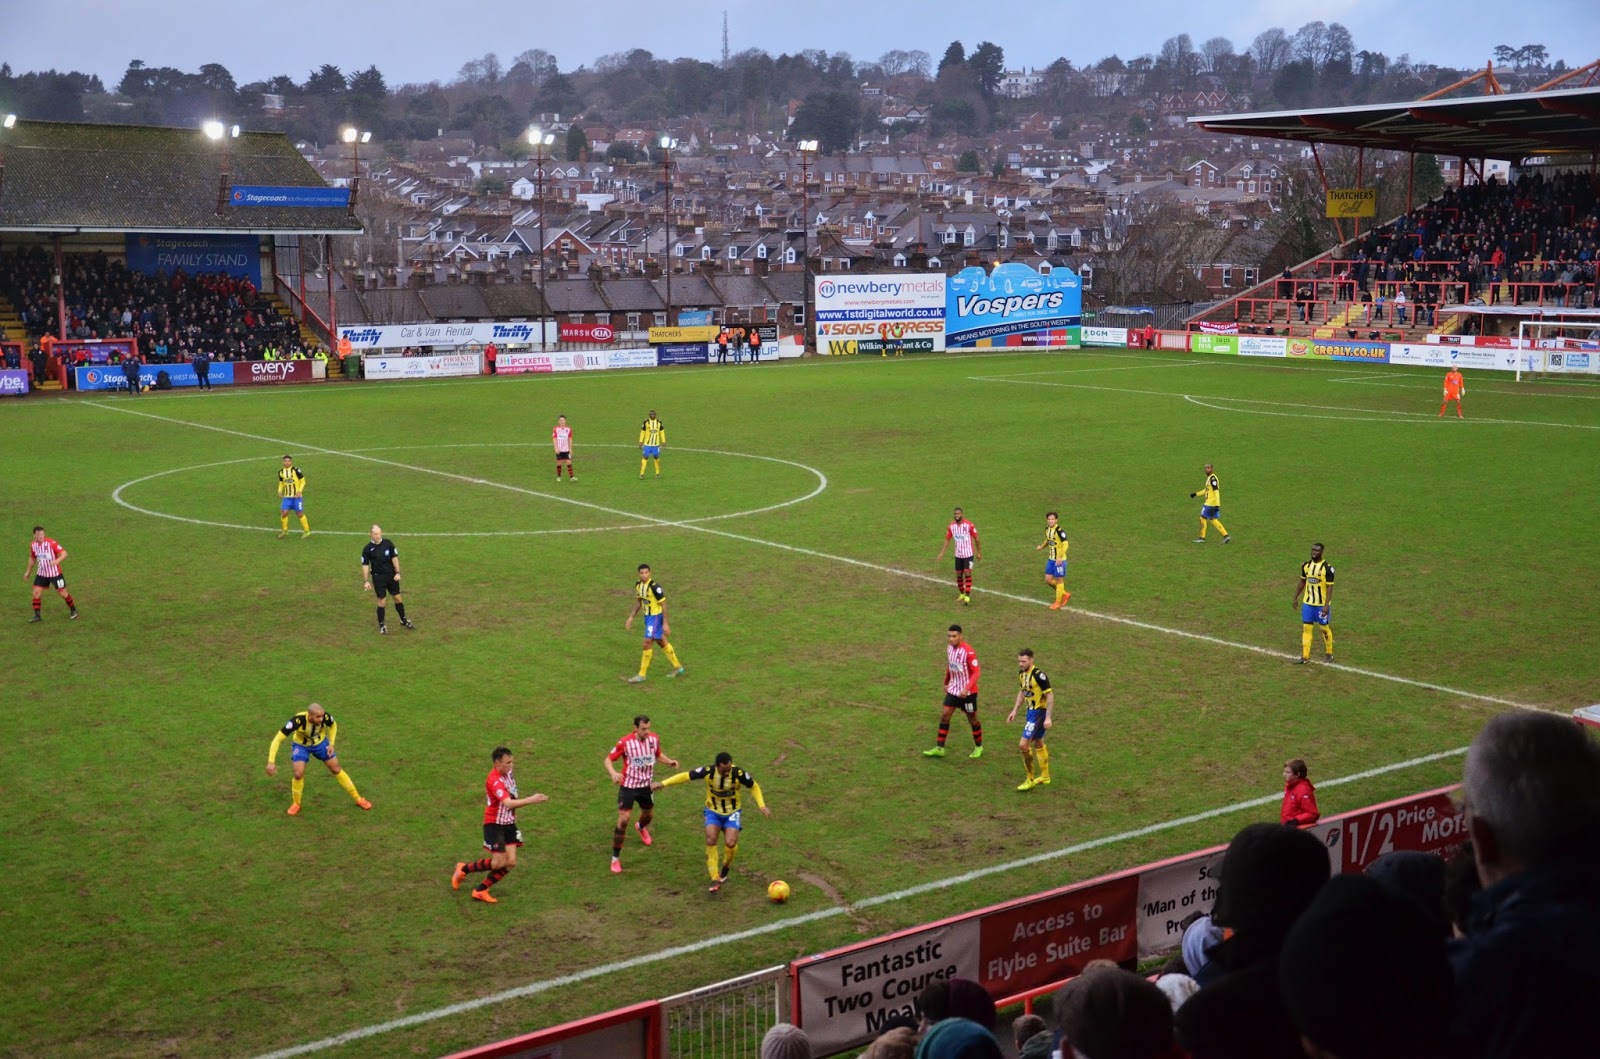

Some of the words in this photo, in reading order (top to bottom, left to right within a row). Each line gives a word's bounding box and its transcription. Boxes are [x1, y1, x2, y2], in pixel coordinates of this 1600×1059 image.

[246, 194, 287, 203] Stagecoach
[1330, 190, 1374, 200] THATCHERS
[1338, 200, 1363, 216] Gold
[156, 239, 209, 249] Stagecoach
[158, 253, 203, 266] FAMILY
[206, 254, 248, 266] STAND
[837, 280, 944, 296] newberymetals
[957, 291, 1064, 318] Vospers
[818, 308, 943, 320] www.1stdigitalworld.co.uk
[400, 328, 416, 338] Car
[416, 328, 422, 337] &
[424, 327, 440, 337] Van
[446, 326, 474, 336] Rental
[493, 324, 534, 341] Thrifty
[562, 329, 590, 337] MARSH
[594, 330, 608, 338] KIA
[651, 330, 682, 338] THATCHERS
[831, 322, 876, 335] SIGNS
[978, 325, 1010, 337] MOTORING
[1030, 320, 1050, 328] SOUTH
[342, 328, 382, 346] Thrifty
[1022, 334, 1072, 342] www.vospers.com
[828, 340, 856, 355] WG
[586, 356, 600, 366] JLL
[251, 362, 295, 380] everys
[252, 374, 282, 382] solicitors
[103, 374, 153, 385] Stagech
[1349, 812, 1395, 866] 1/2
[1396, 805, 1436, 828] Price
[1181, 890, 1197, 906] of
[1200, 886, 1222, 902] the
[1012, 912, 1075, 942] Access
[1082, 903, 1104, 922] to
[988, 948, 1038, 981] Flybe
[1045, 934, 1092, 963] Suite
[1098, 924, 1128, 946] Bar
[841, 941, 943, 987] Fantastic
[824, 989, 874, 1019] Two
